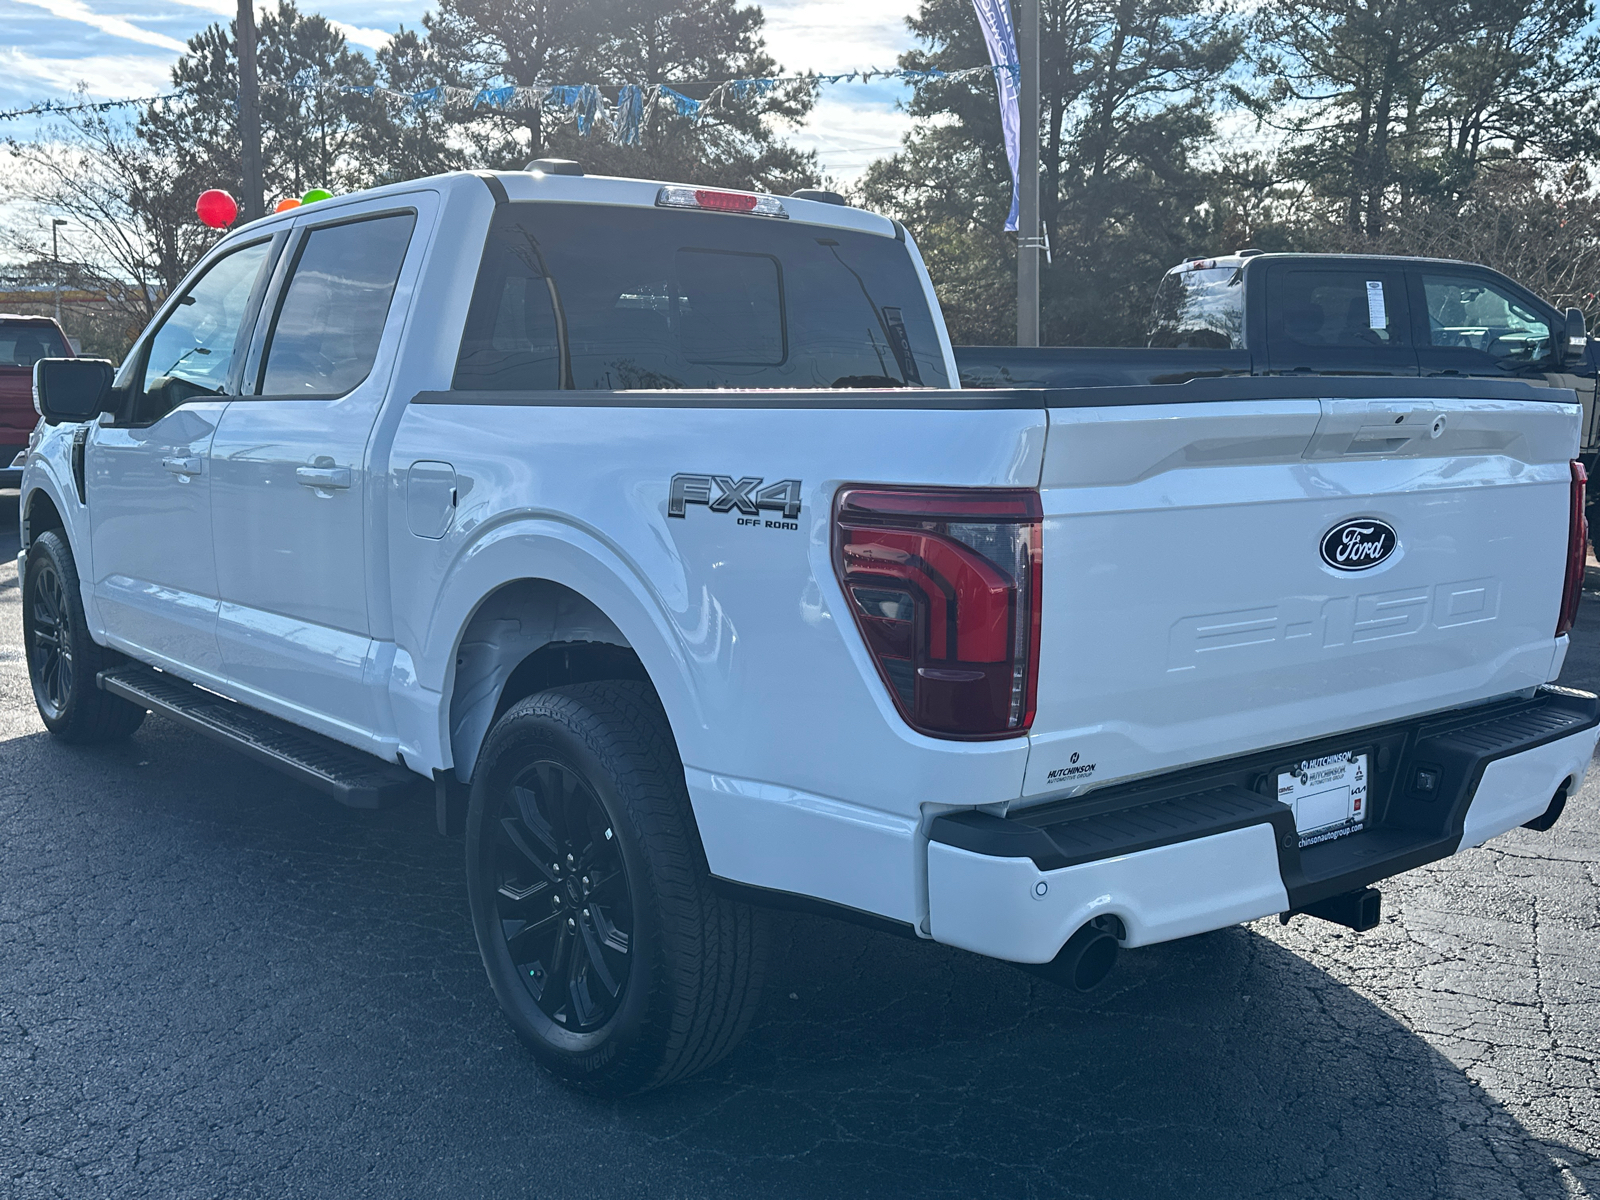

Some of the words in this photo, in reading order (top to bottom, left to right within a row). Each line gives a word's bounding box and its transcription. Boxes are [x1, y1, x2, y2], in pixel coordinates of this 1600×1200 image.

[668, 472, 803, 519] FX4
[737, 518, 761, 527] OFF
[764, 520, 799, 530] ROAD
[1336, 527, 1386, 562] Ford
[1166, 575, 1502, 673] F-150
[1309, 751, 1352, 769] HUTCHINSON
[1047, 763, 1097, 779] HUTCHINSON
[1047, 775, 1076, 784] AUTOMOTIVE
[1076, 772, 1093, 780] GROUP
[1278, 785, 1294, 793] GMC
